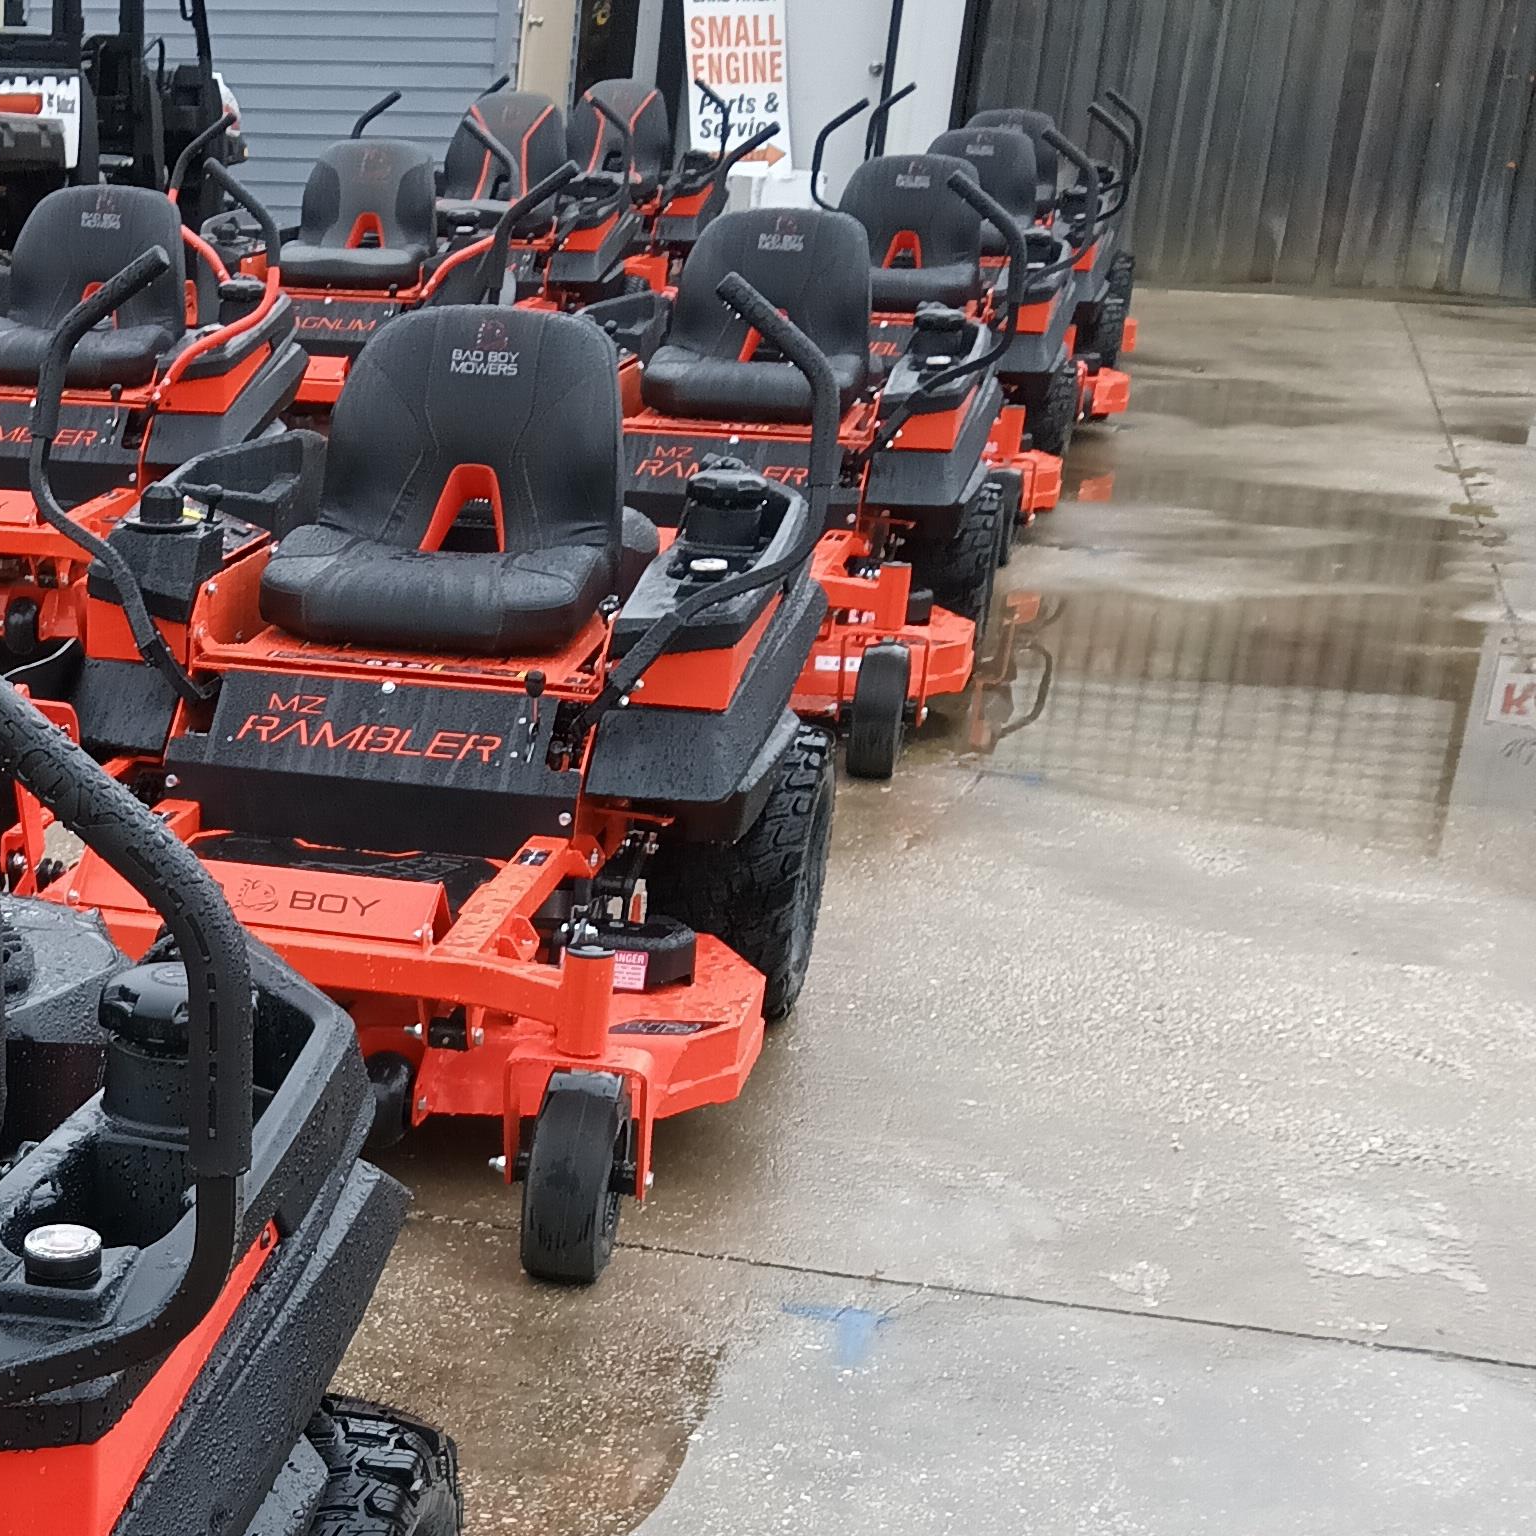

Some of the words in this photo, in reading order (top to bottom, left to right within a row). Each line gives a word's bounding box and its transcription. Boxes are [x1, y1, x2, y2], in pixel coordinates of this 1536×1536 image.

[690, 14, 782, 48] SMALL
[692, 51, 782, 84] ENGINE
[764, 92, 779, 113] &
[699, 117, 772, 139] Servic
[452, 348, 484, 361] BAD
[488, 351, 520, 362] BOY
[450, 360, 518, 376] MOWERS
[655, 446, 694, 458] MZ
[268, 693, 327, 715] MZ
[236, 715, 502, 763] RAMBLER
[289, 890, 382, 916] BOY
